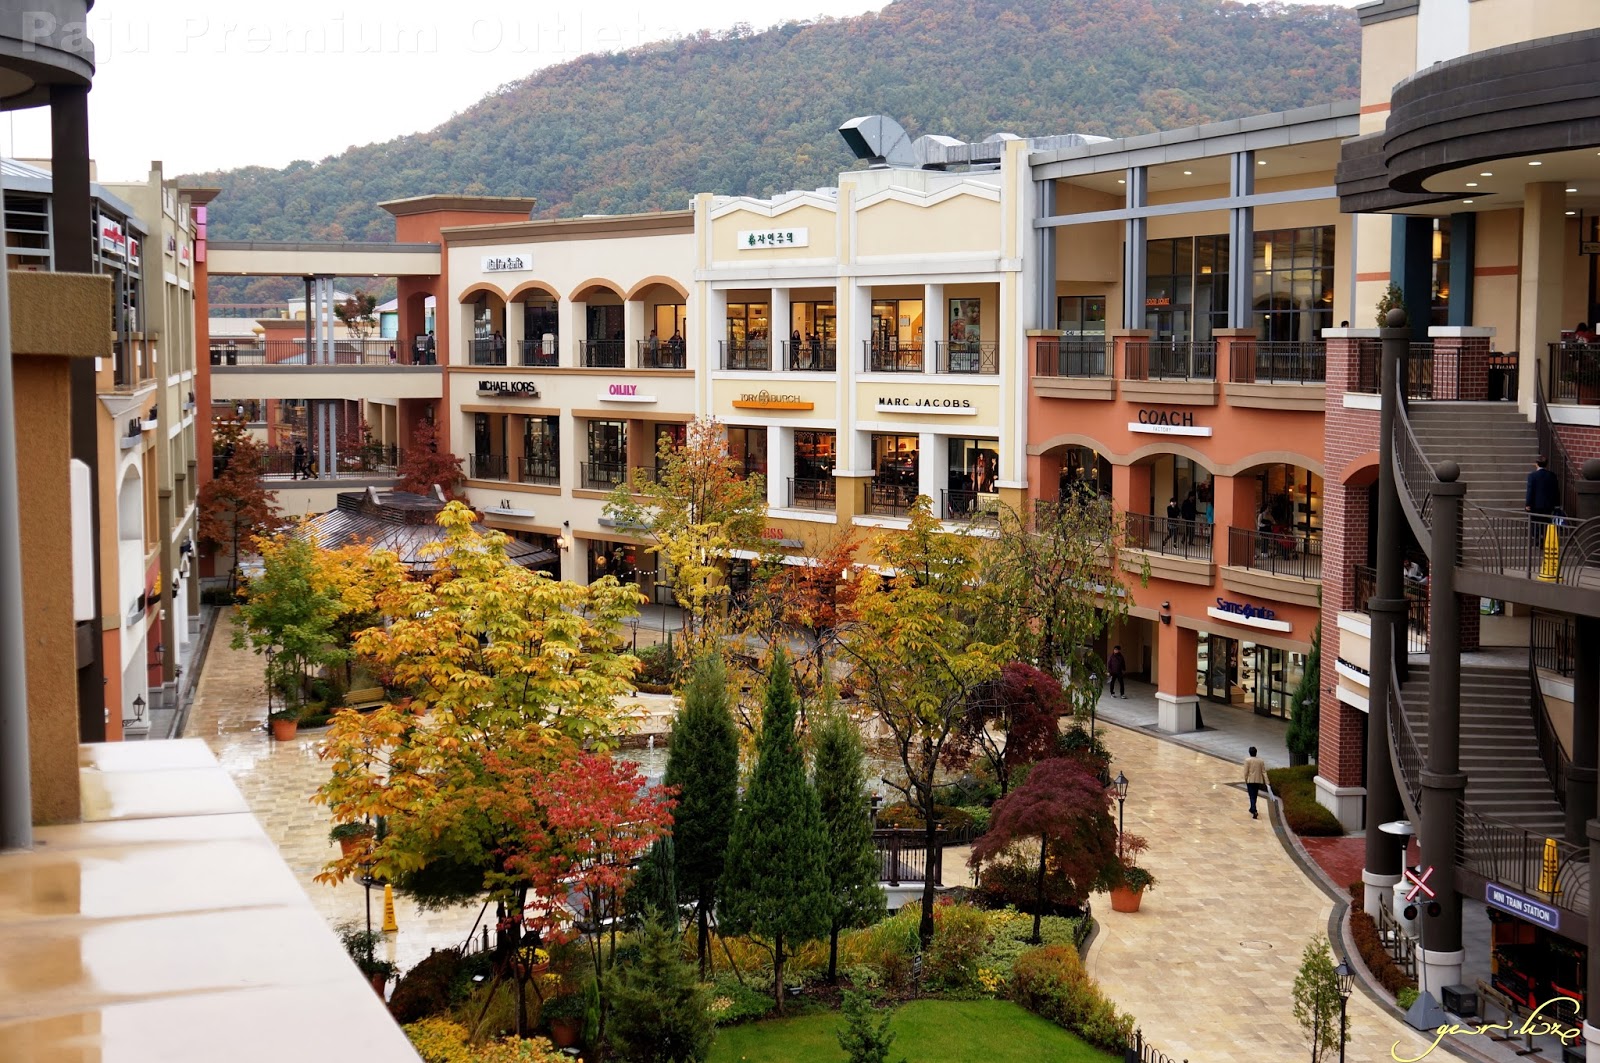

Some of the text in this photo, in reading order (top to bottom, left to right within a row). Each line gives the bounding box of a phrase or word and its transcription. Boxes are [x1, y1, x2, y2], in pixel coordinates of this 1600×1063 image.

[757, 232, 793, 245] 자연주의
[478, 380, 535, 392] MICHAEL KORS
[609, 384, 637, 396] OILILY
[740, 393, 801, 403] TORY BURCH
[878, 397, 970, 408] MARC JACOBS
[1138, 409, 1193, 427] COACH
[1216, 597, 1275, 620] Samsonite
[1493, 890, 1549, 921] MINI TRAIN STATION
